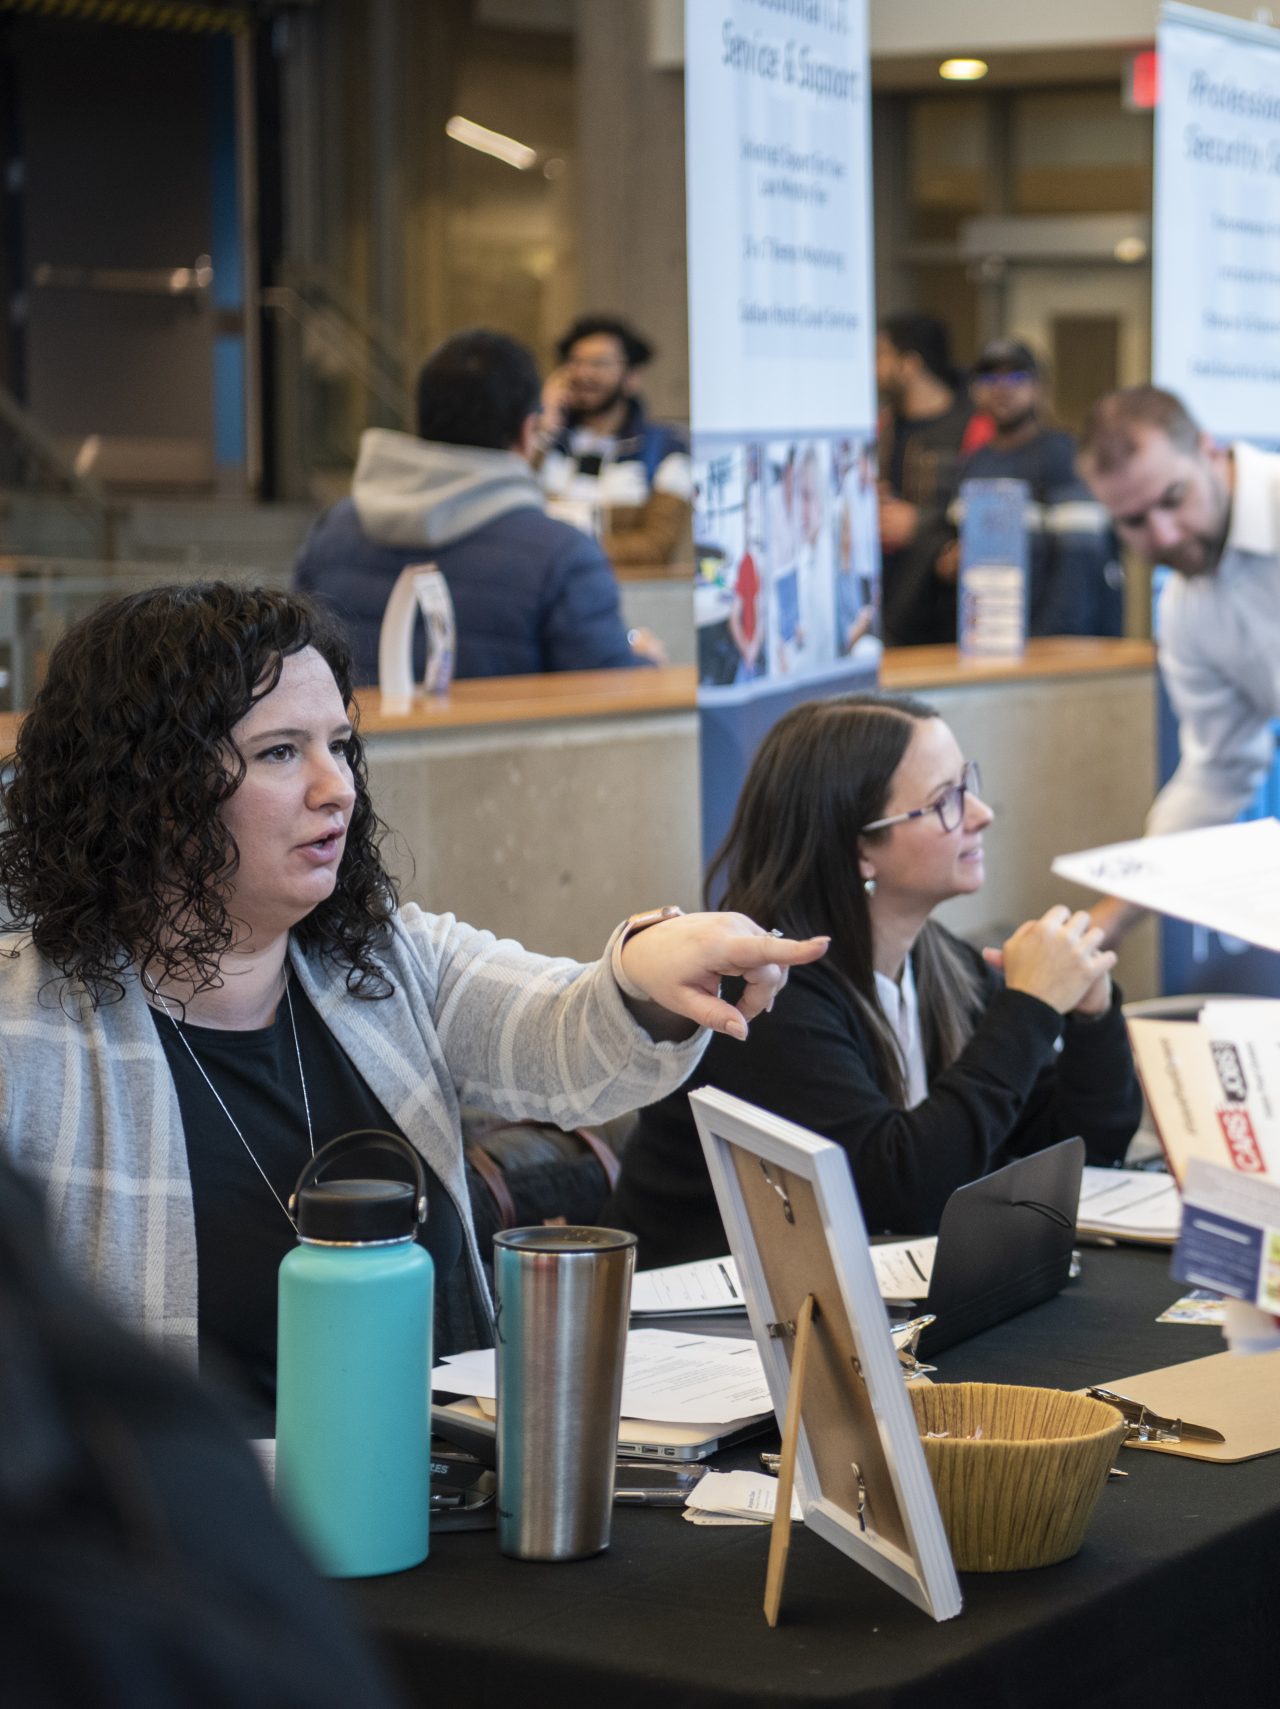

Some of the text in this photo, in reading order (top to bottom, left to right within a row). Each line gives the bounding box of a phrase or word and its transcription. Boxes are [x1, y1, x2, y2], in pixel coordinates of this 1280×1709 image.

[721, 20, 861, 104] Service & Support
[1184, 125, 1263, 173] Security
[1220, 1112, 1263, 1171] CARS
